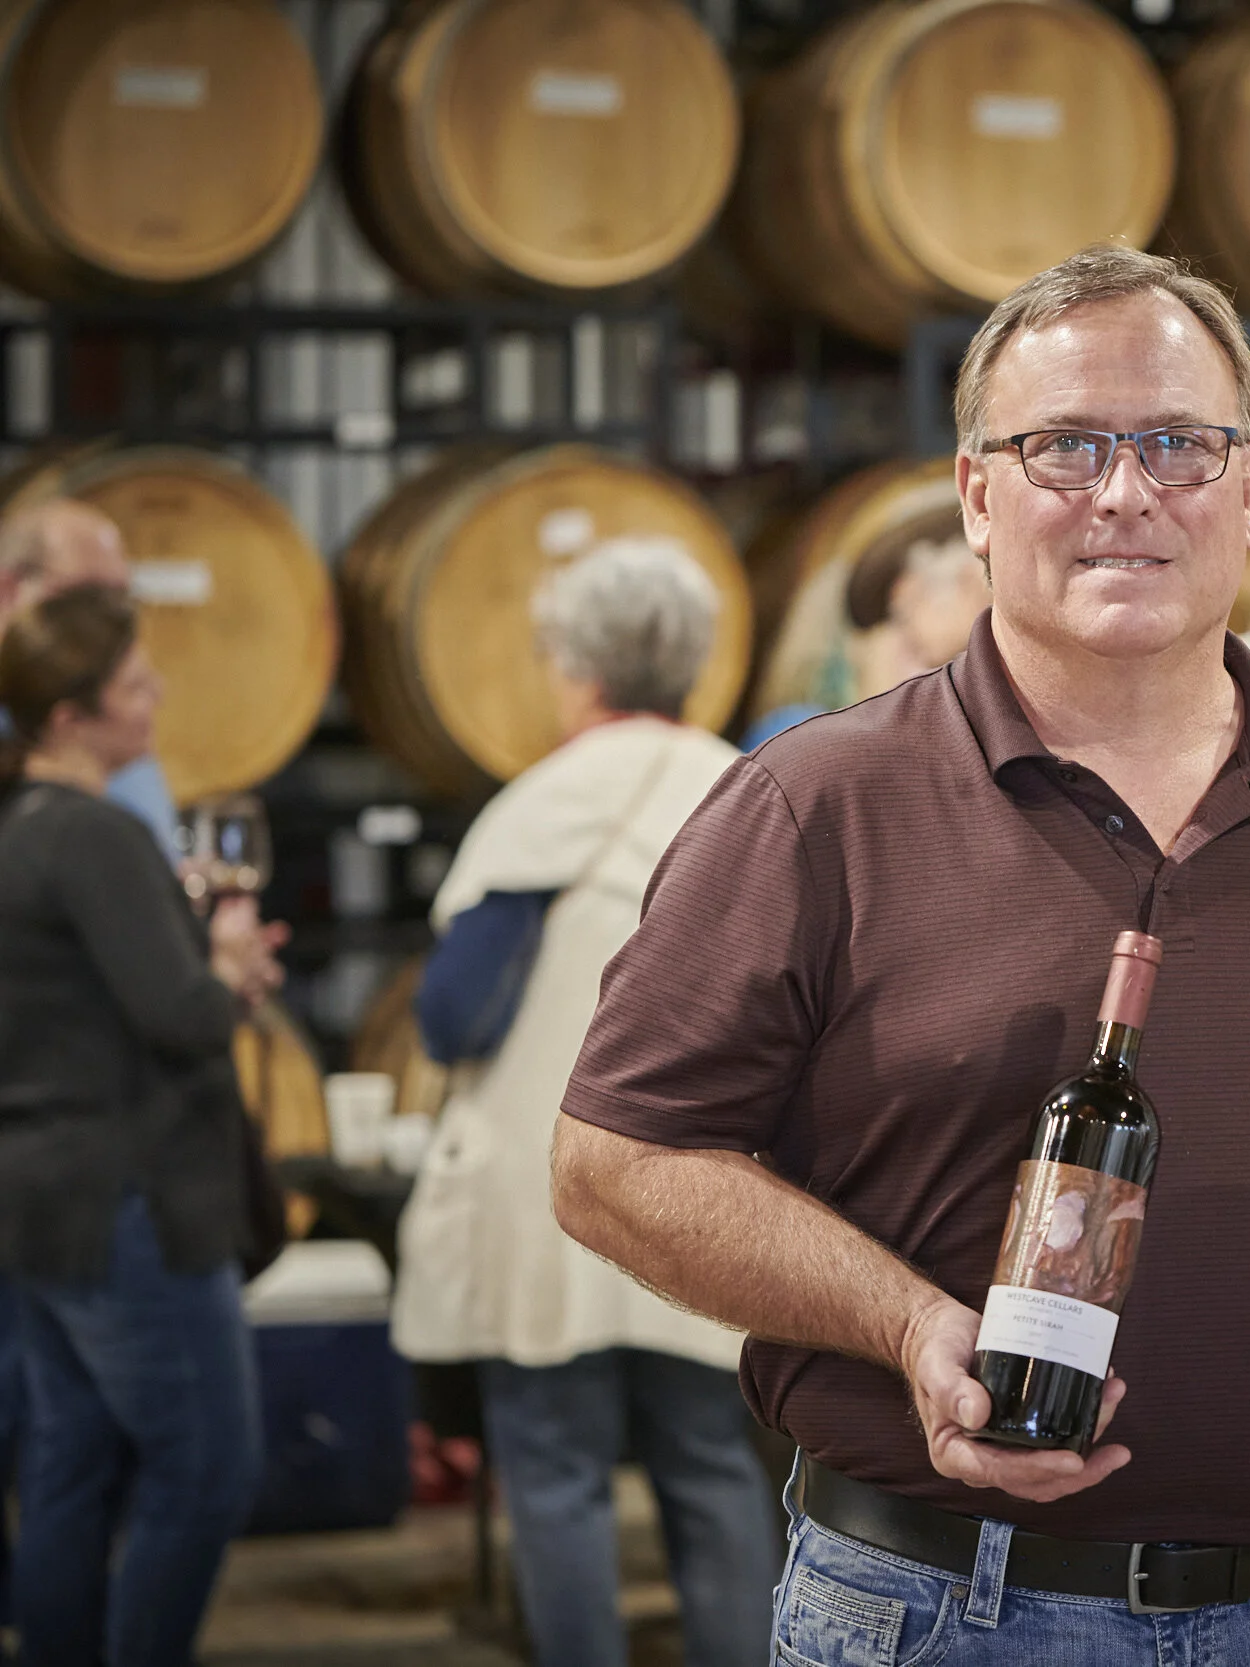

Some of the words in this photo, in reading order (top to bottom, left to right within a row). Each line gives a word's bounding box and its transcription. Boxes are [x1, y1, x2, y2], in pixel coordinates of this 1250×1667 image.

[1006, 1292, 1046, 1306] WESTCAVE
[1047, 1299, 1084, 1315] CELLARS
[1013, 1314, 1037, 1325] PETITE
